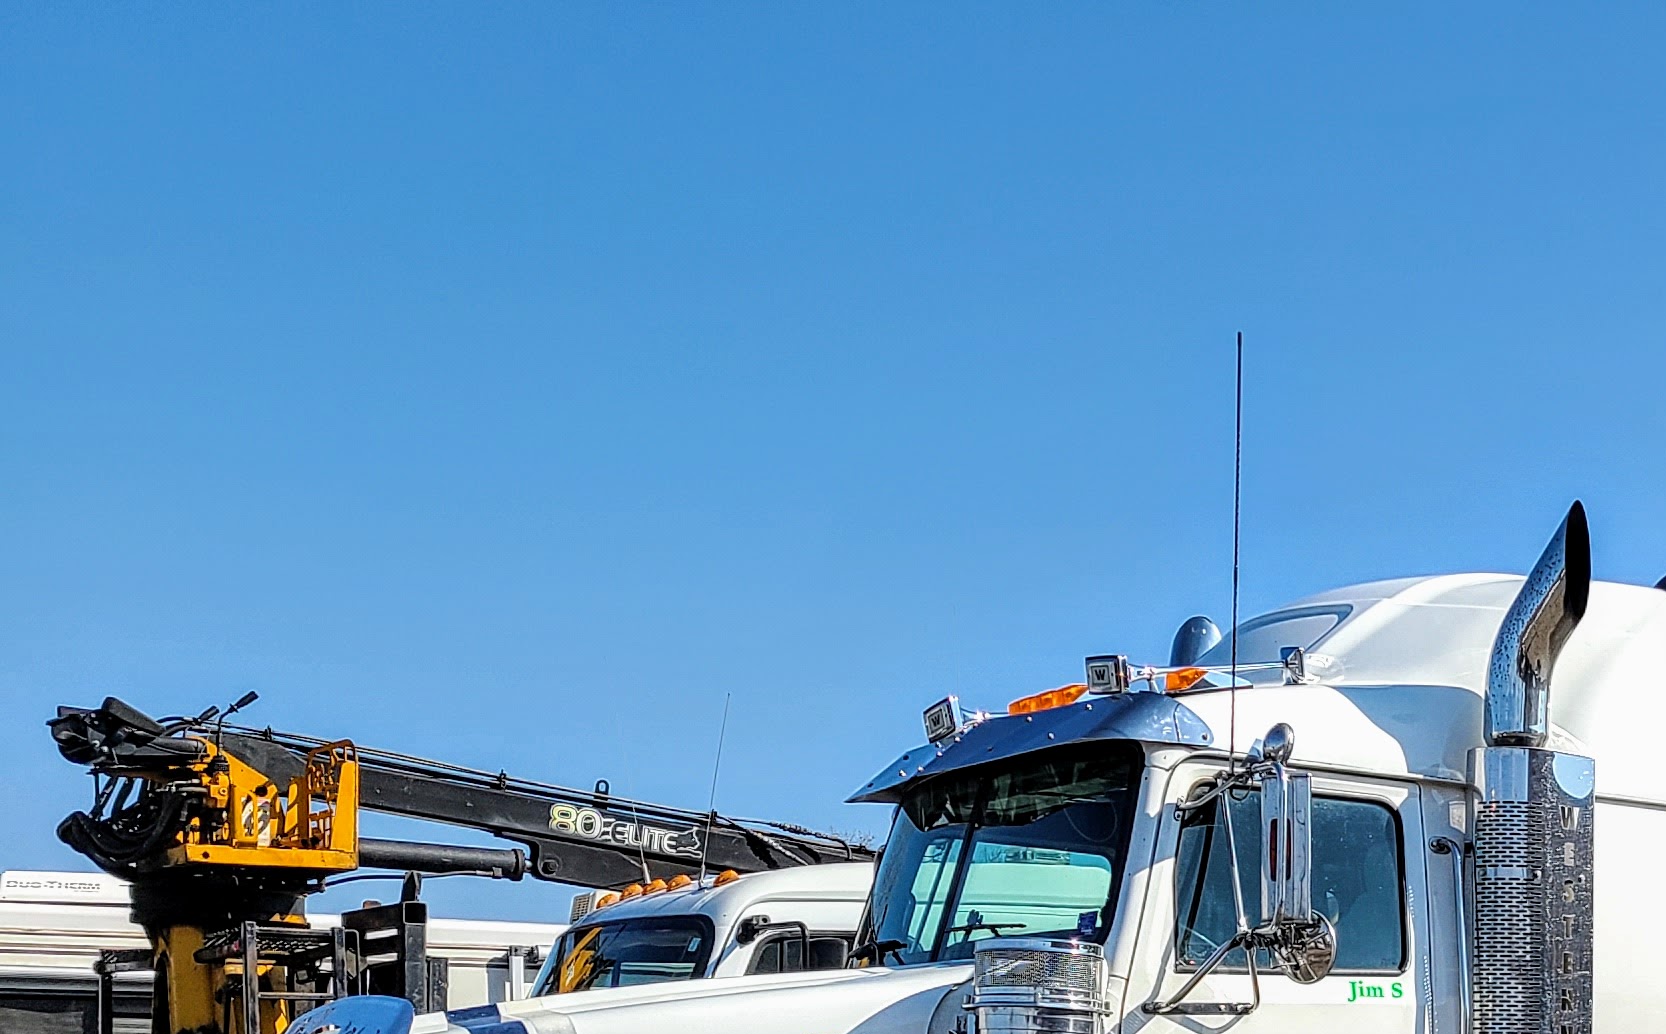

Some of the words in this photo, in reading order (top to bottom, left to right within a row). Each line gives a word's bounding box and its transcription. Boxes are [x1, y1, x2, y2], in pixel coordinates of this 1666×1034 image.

[1095, 669, 1107, 681] W
[549, 803, 602, 840] 80
[610, 821, 679, 854] ELITE
[1348, 980, 1385, 1001] Jim
[1391, 982, 1404, 998] S
